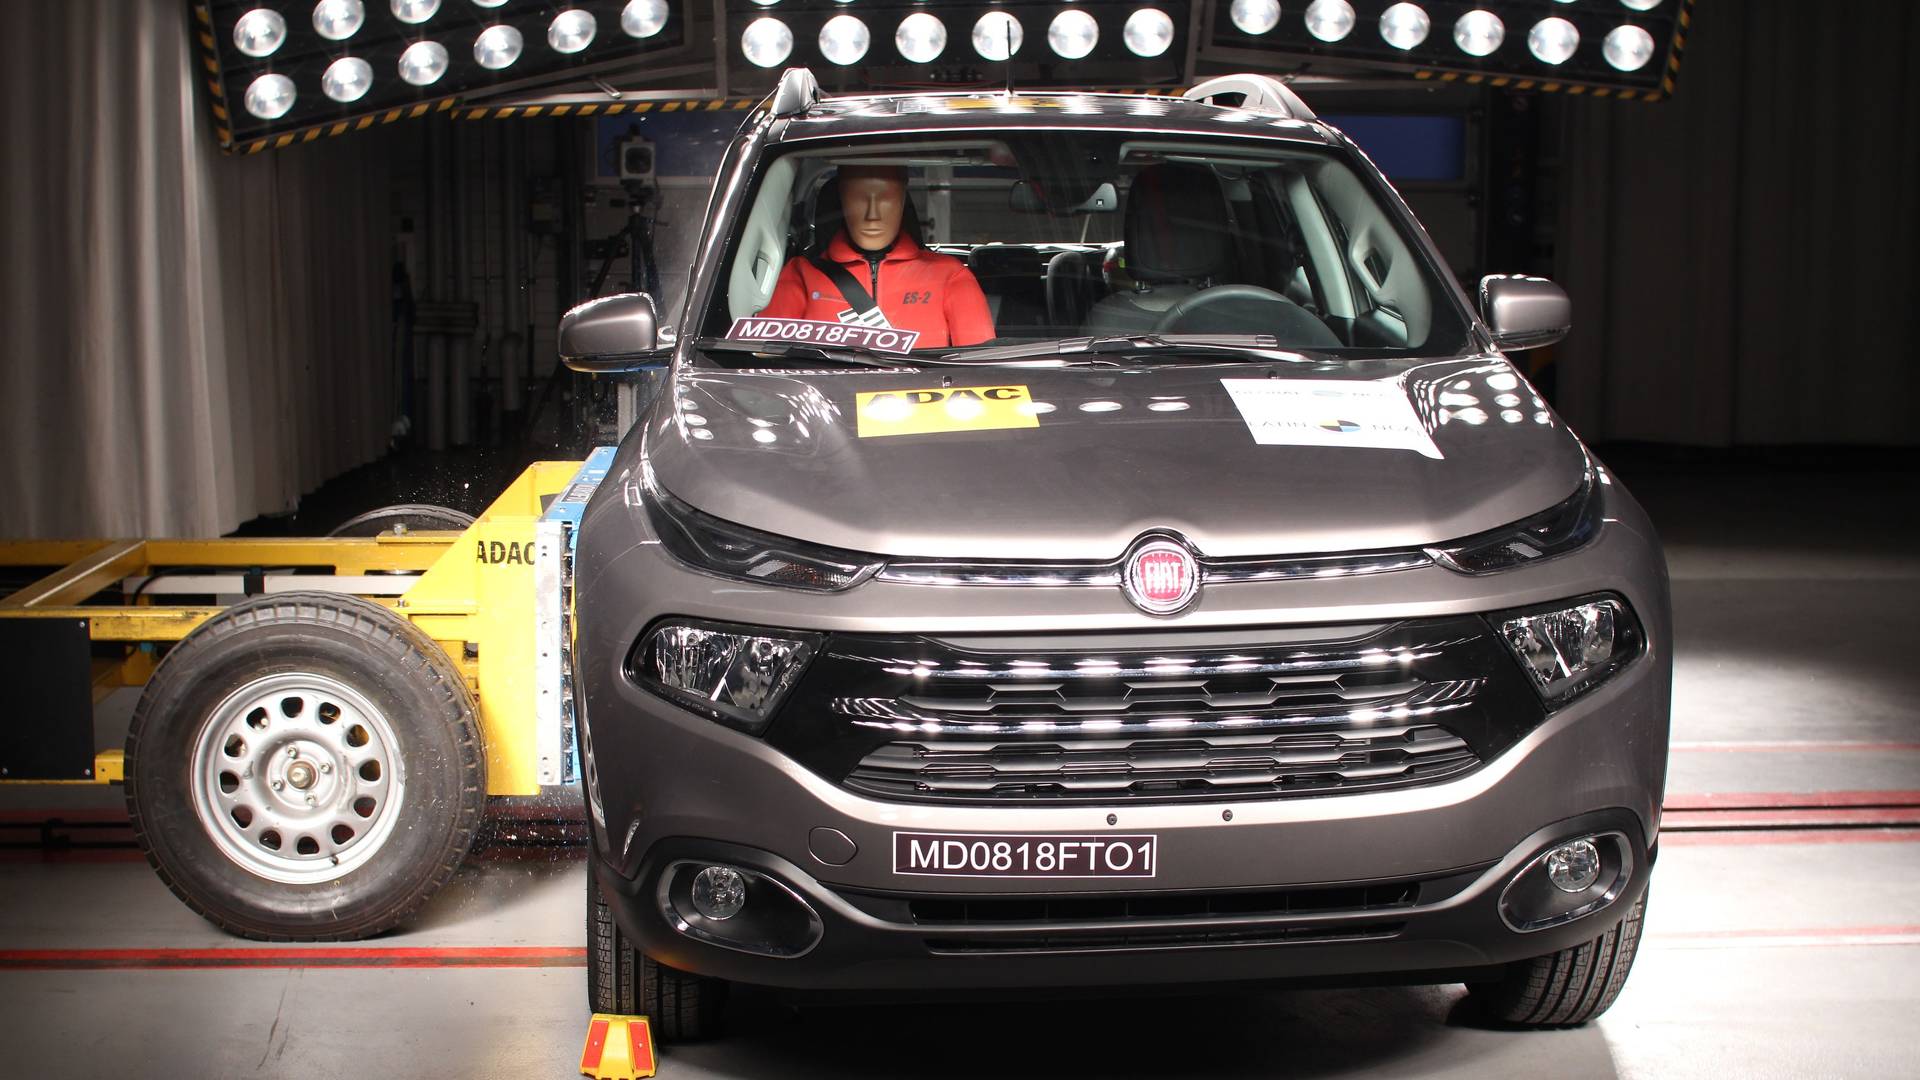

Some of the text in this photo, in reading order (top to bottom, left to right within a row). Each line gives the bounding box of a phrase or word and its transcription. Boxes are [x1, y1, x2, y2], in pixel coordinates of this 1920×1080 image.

[902, 290, 932, 305] ES-2
[476, 540, 536, 566] ADAC
[1144, 561, 1181, 593] FIAT
